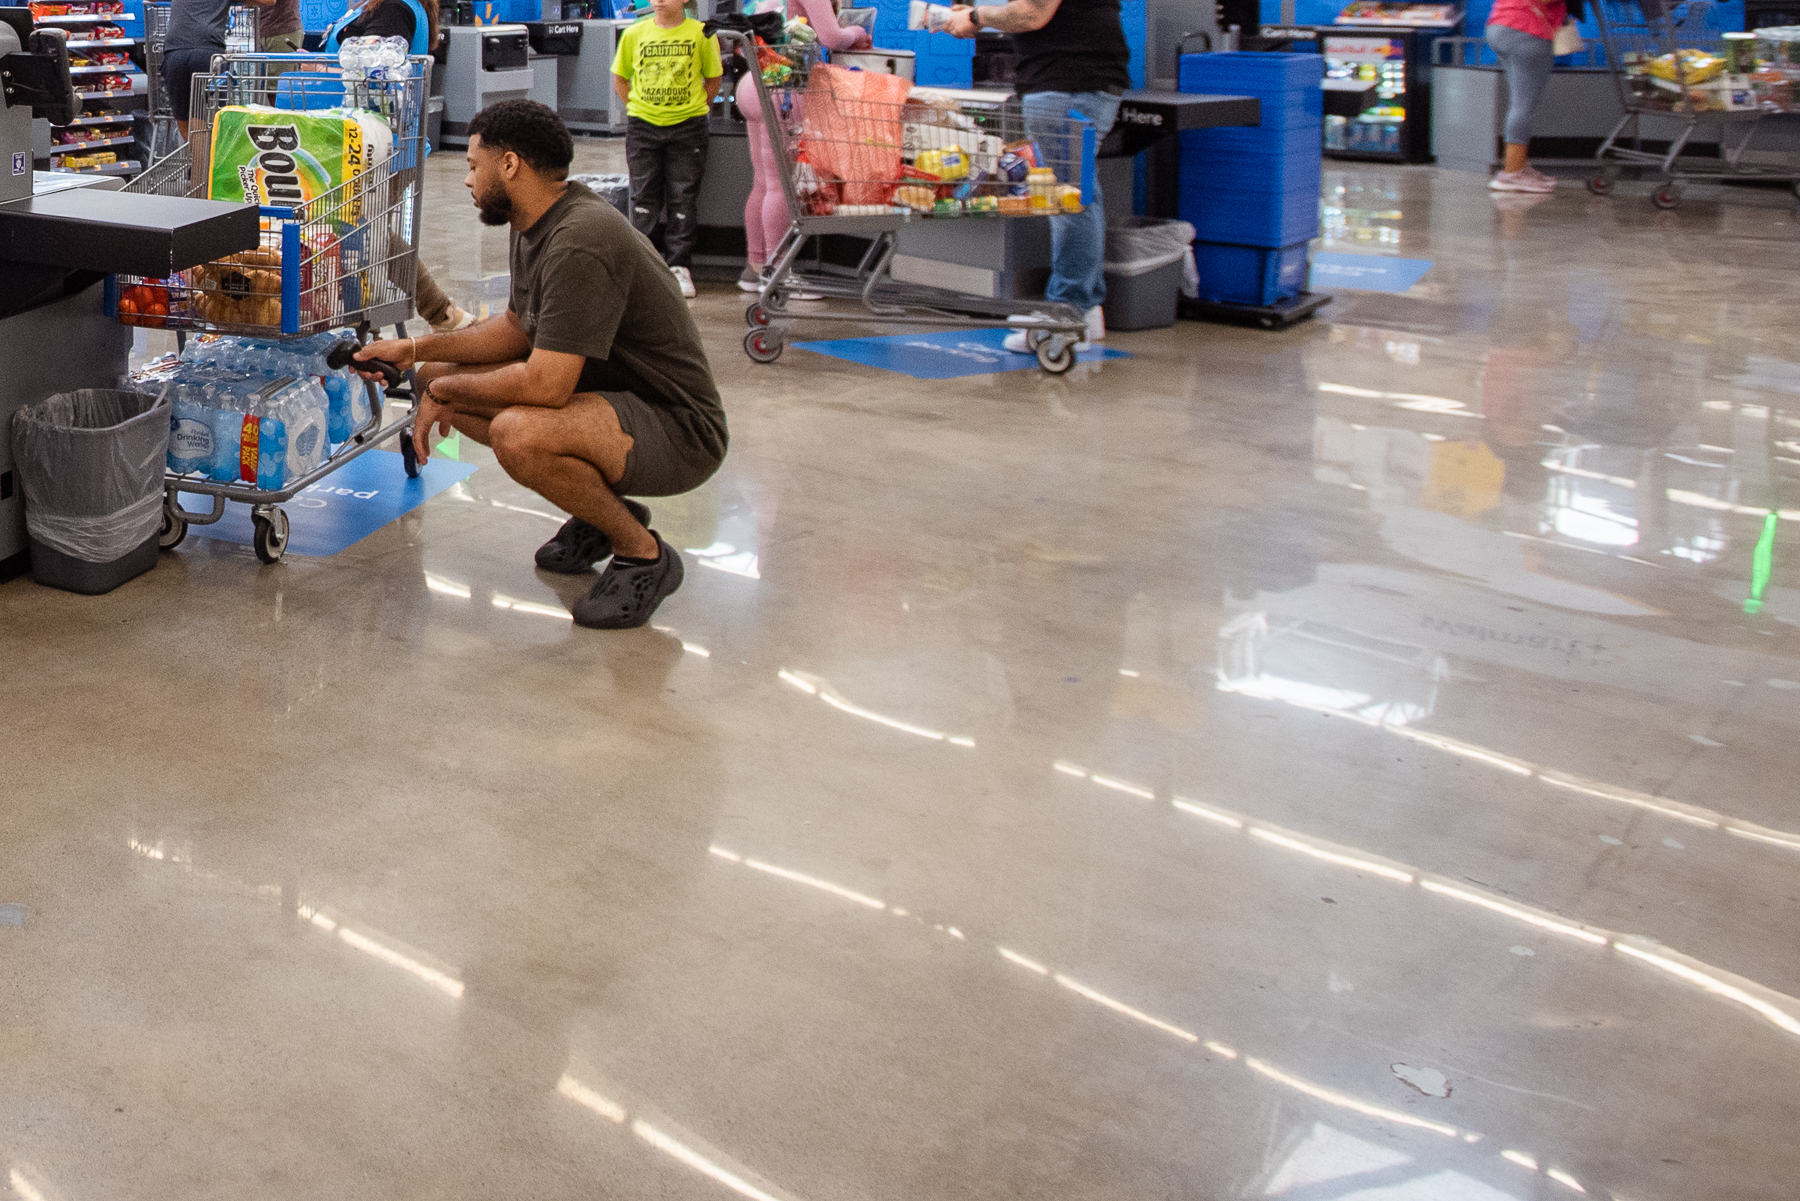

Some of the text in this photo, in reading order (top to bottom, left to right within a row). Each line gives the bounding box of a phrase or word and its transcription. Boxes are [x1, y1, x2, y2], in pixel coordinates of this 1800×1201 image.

[554, 25, 579, 34] Cart Here
[646, 45, 689, 56] CAUTION!
[642, 86, 688, 96] HAZARDOUS
[1122, 107, 1163, 126] Here
[238, 166, 250, 193] Picker
[243, 423, 259, 436] 40
[177, 433, 209, 445] Drinking
[242, 445, 251, 466] PACK
